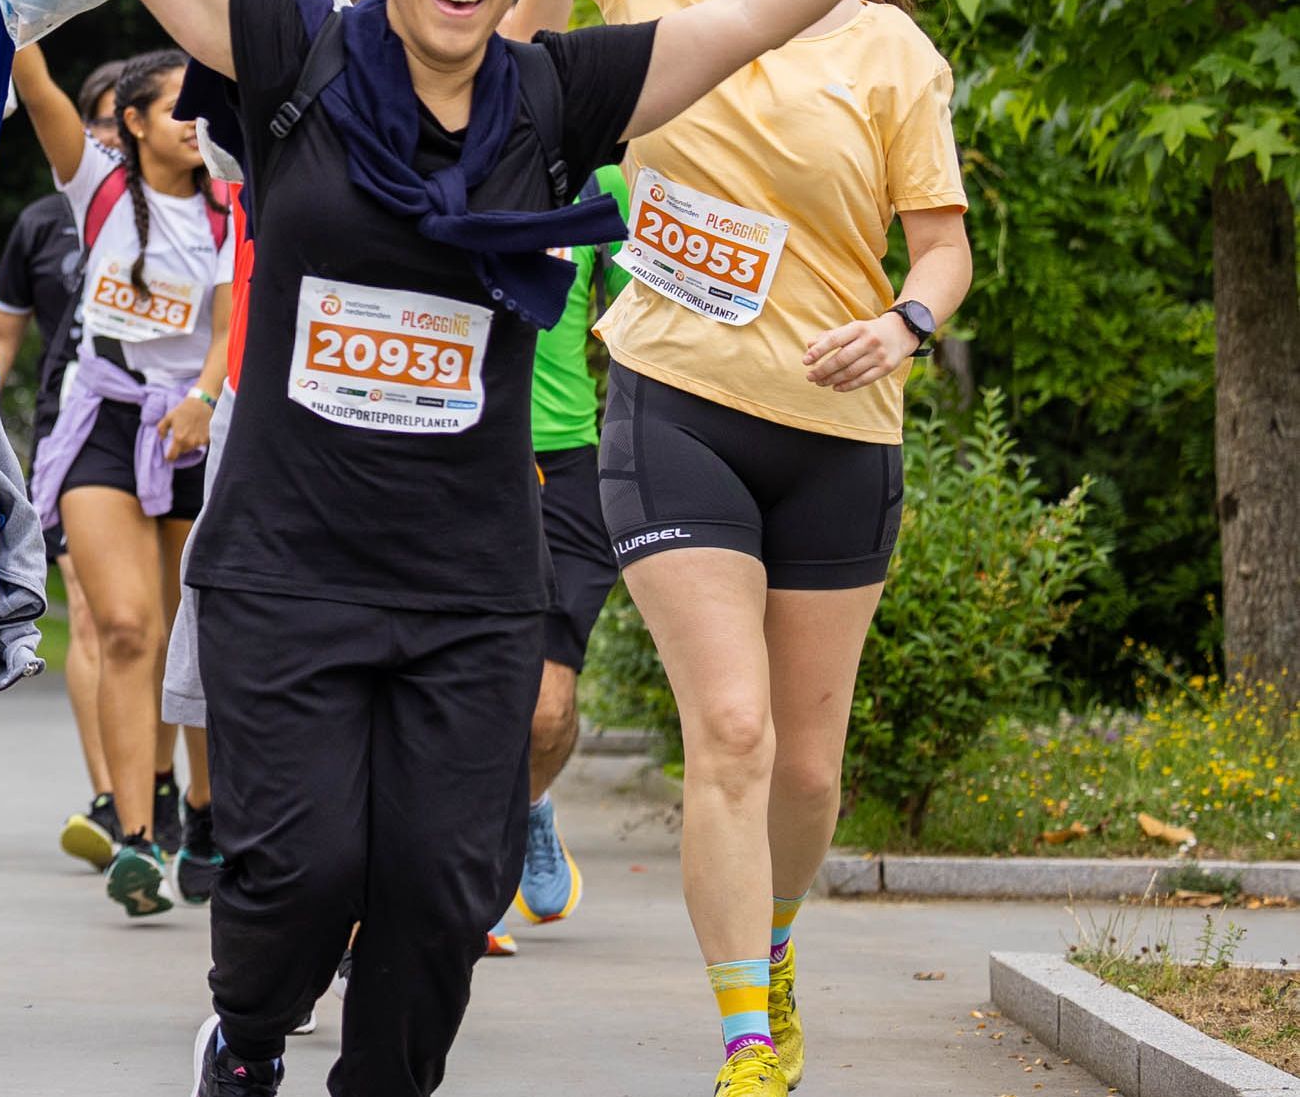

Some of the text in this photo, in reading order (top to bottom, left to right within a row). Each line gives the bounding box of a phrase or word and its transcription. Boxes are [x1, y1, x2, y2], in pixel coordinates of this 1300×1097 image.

[705, 212, 769, 245] PLOGGING
[640, 211, 760, 284] 20953
[630, 265, 739, 322] #HAZDEPORTEPORELPLANETA
[400, 310, 469, 338] PLOGGING
[312, 329, 464, 384] 20939
[311, 401, 459, 428] #HAZDEPORTEPORELPLANETA
[618, 527, 691, 554] LURBEL
